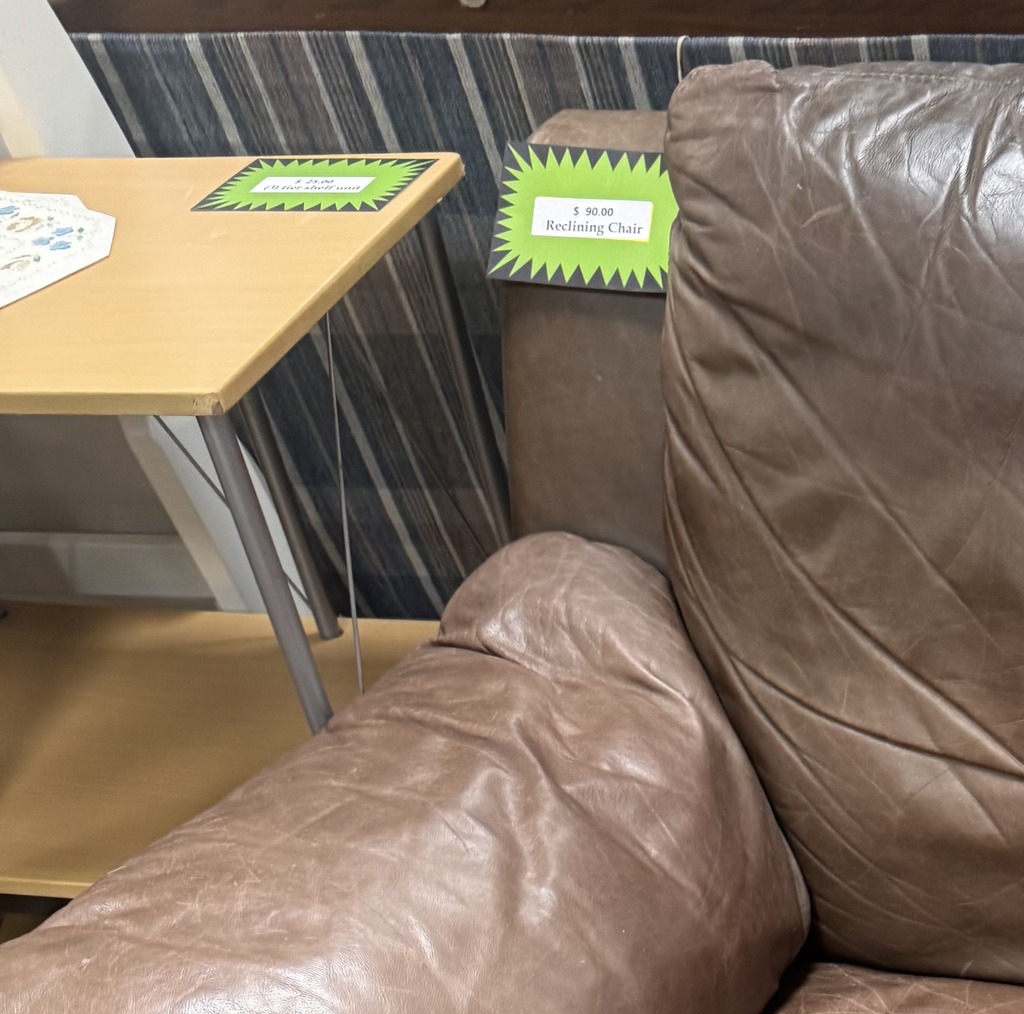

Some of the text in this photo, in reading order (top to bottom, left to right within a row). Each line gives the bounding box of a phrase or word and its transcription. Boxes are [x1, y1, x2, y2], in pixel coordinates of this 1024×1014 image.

[573, 206, 614, 217] $ 90.00
[546, 219, 644, 236] Reclining Chair
